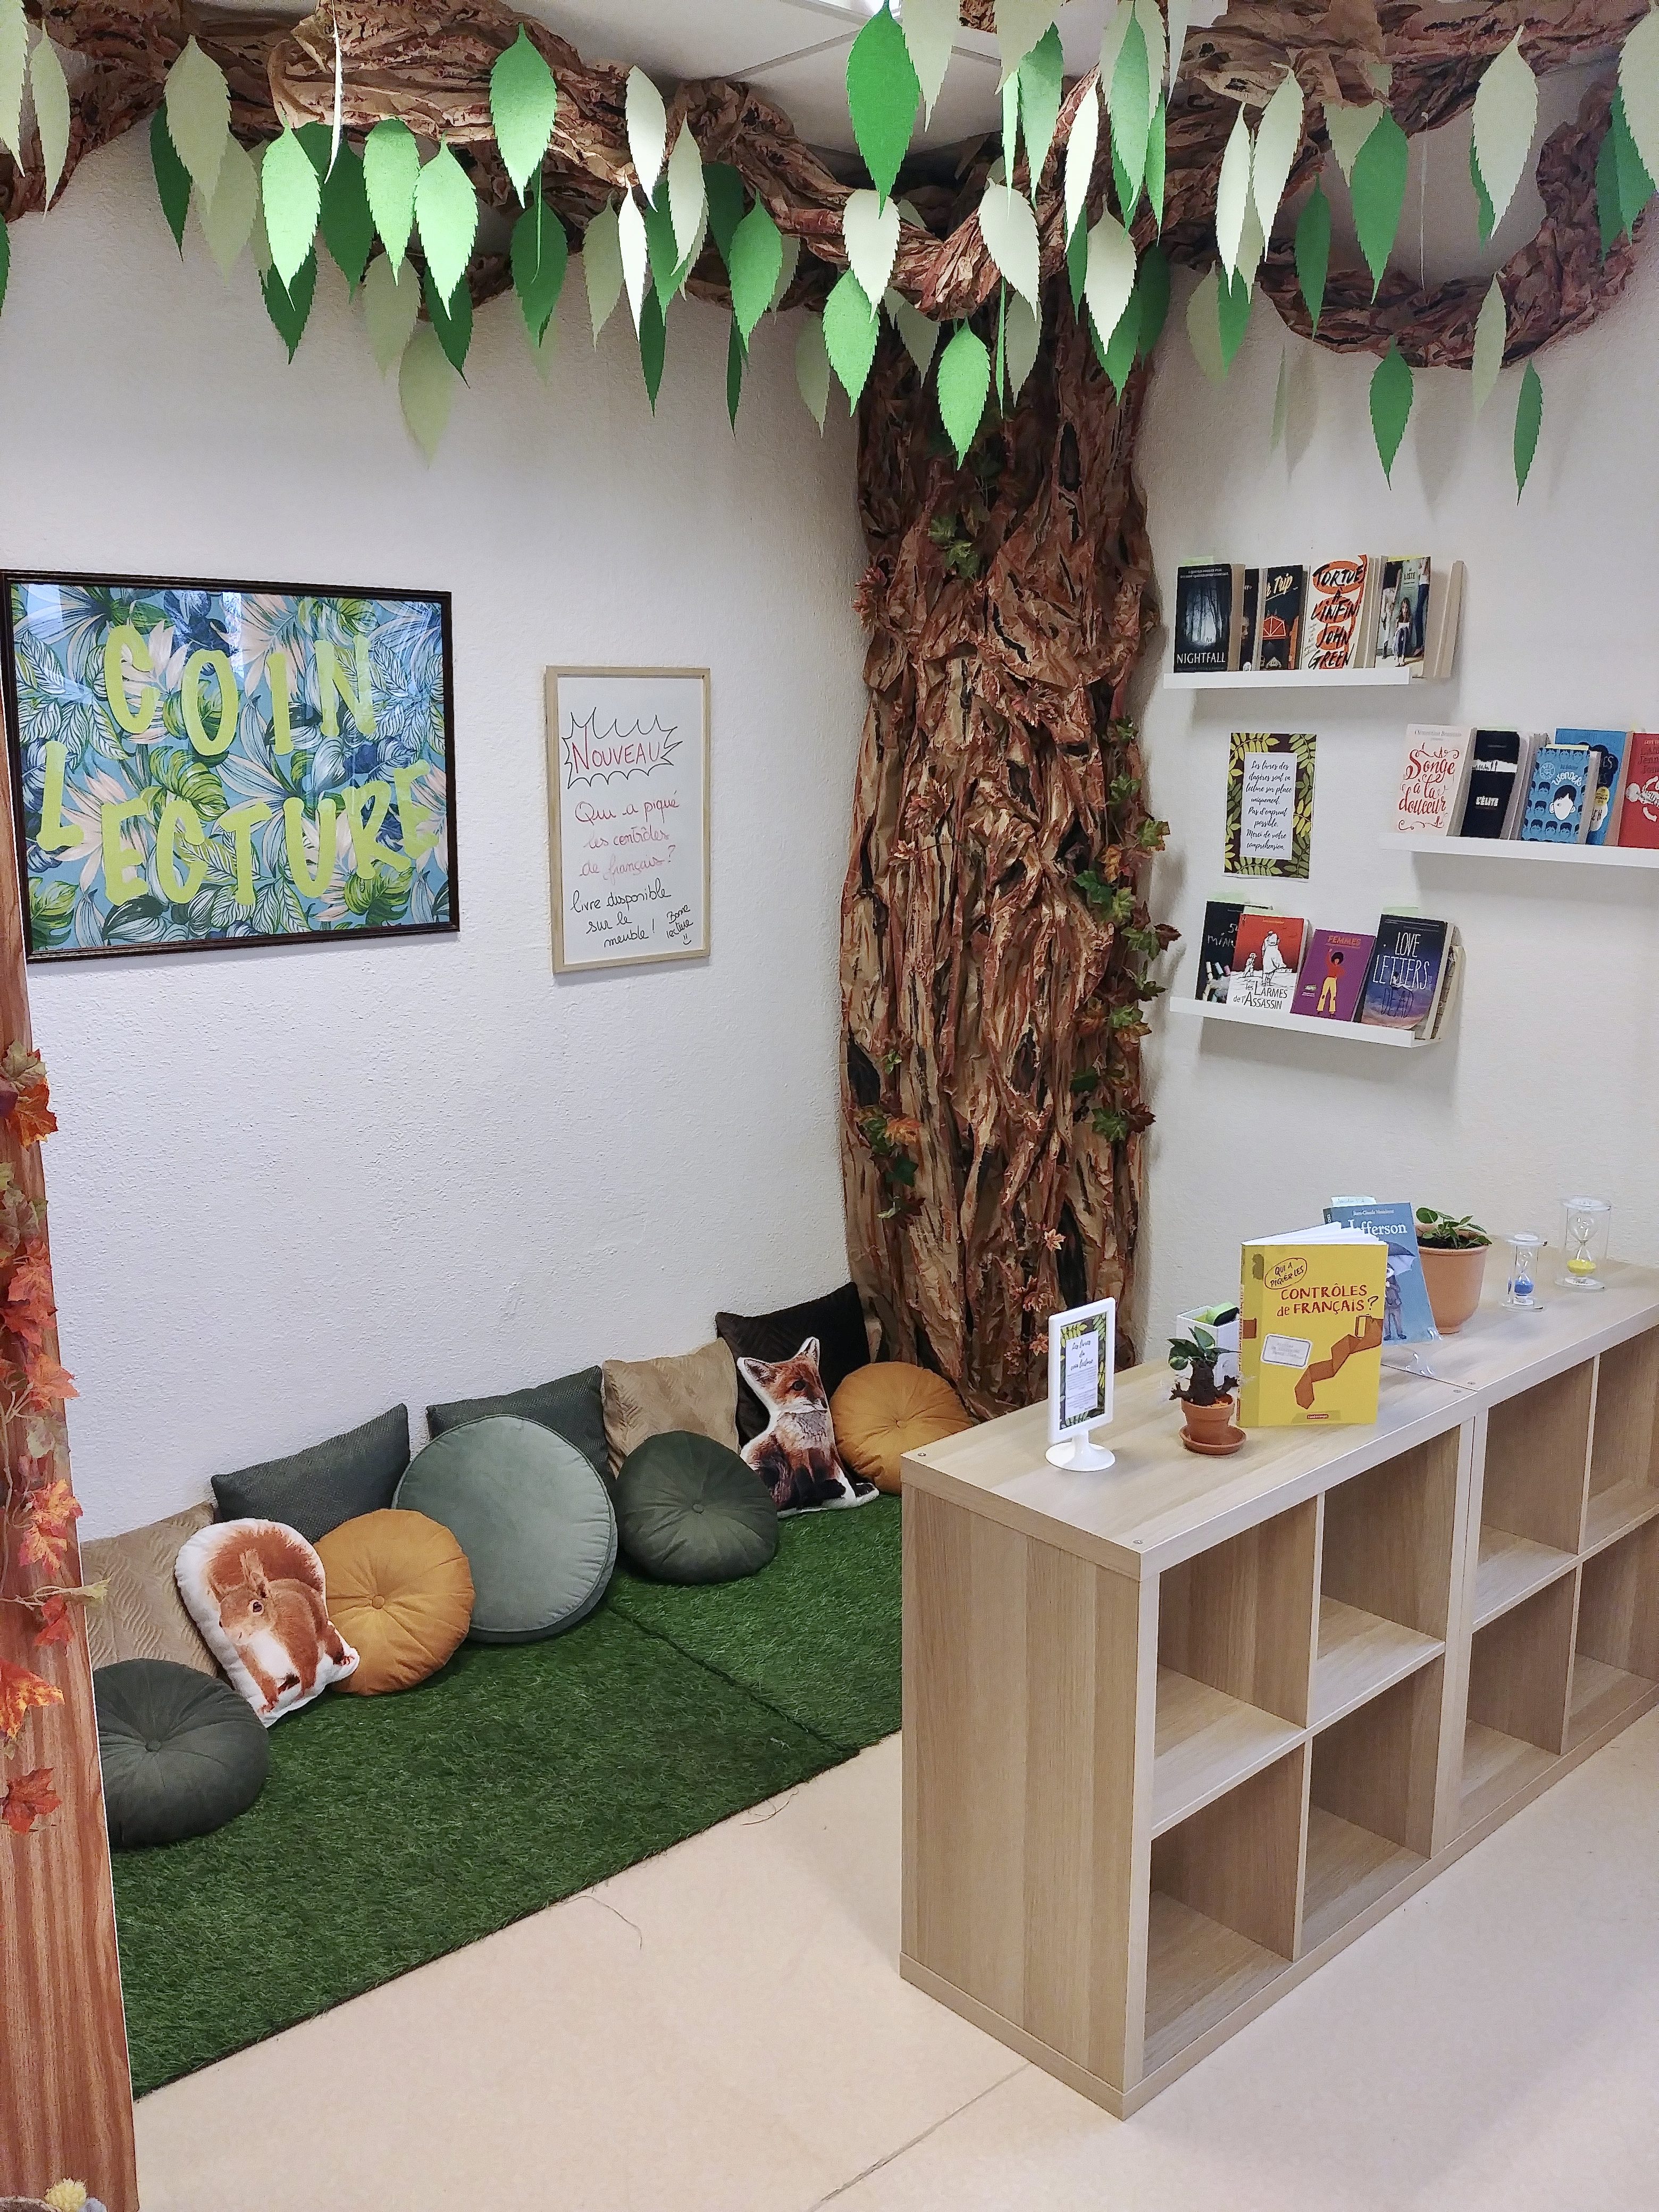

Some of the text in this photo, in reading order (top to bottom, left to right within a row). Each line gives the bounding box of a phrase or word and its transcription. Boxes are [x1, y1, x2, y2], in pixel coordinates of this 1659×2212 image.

[1273, 572, 1293, 595] Trip
[1316, 623, 1350, 649] JOHN
[1176, 652, 1226, 664] NIGHTFALL
[1308, 643, 1355, 670] GREEN
[105, 624, 377, 756] COIN
[572, 724, 660, 774] NOUVEAU
[1251, 760, 1289, 770] Les livres des
[1403, 749, 1455, 783] Songe
[1246, 782, 1264, 792] lecture
[1275, 783, 1292, 795] place
[1249, 772, 1269, 784] étagères
[1271, 772, 1284, 782] sont
[1413, 774, 1436, 799] à la
[575, 790, 680, 826] Qui a piqué
[1248, 806, 1259, 816] Pas
[1398, 786, 1446, 815] douceur
[1476, 795, 1499, 807] L'ÉLITE
[37, 740, 440, 906] LECTURE
[1246, 828, 1262, 839] Merci
[1272, 830, 1286, 840] votre
[583, 824, 669, 849] les contrôles
[579, 859, 600, 877] de
[570, 877, 672, 913] livre disponible
[585, 911, 633, 934] sur le
[1395, 932, 1421, 958] LOVE
[1372, 954, 1430, 990] LETTERS
[1254, 981, 1288, 999] LARMES
[1380, 988, 1414, 1018] DEAD
[1347, 1218, 1408, 1235] Jfferson
[1275, 1264, 1286, 1277] QUI
[1294, 1265, 1304, 1277] LES
[1280, 1283, 1368, 1300] CONTRÔLES
[1277, 1306, 1290, 1317] de
